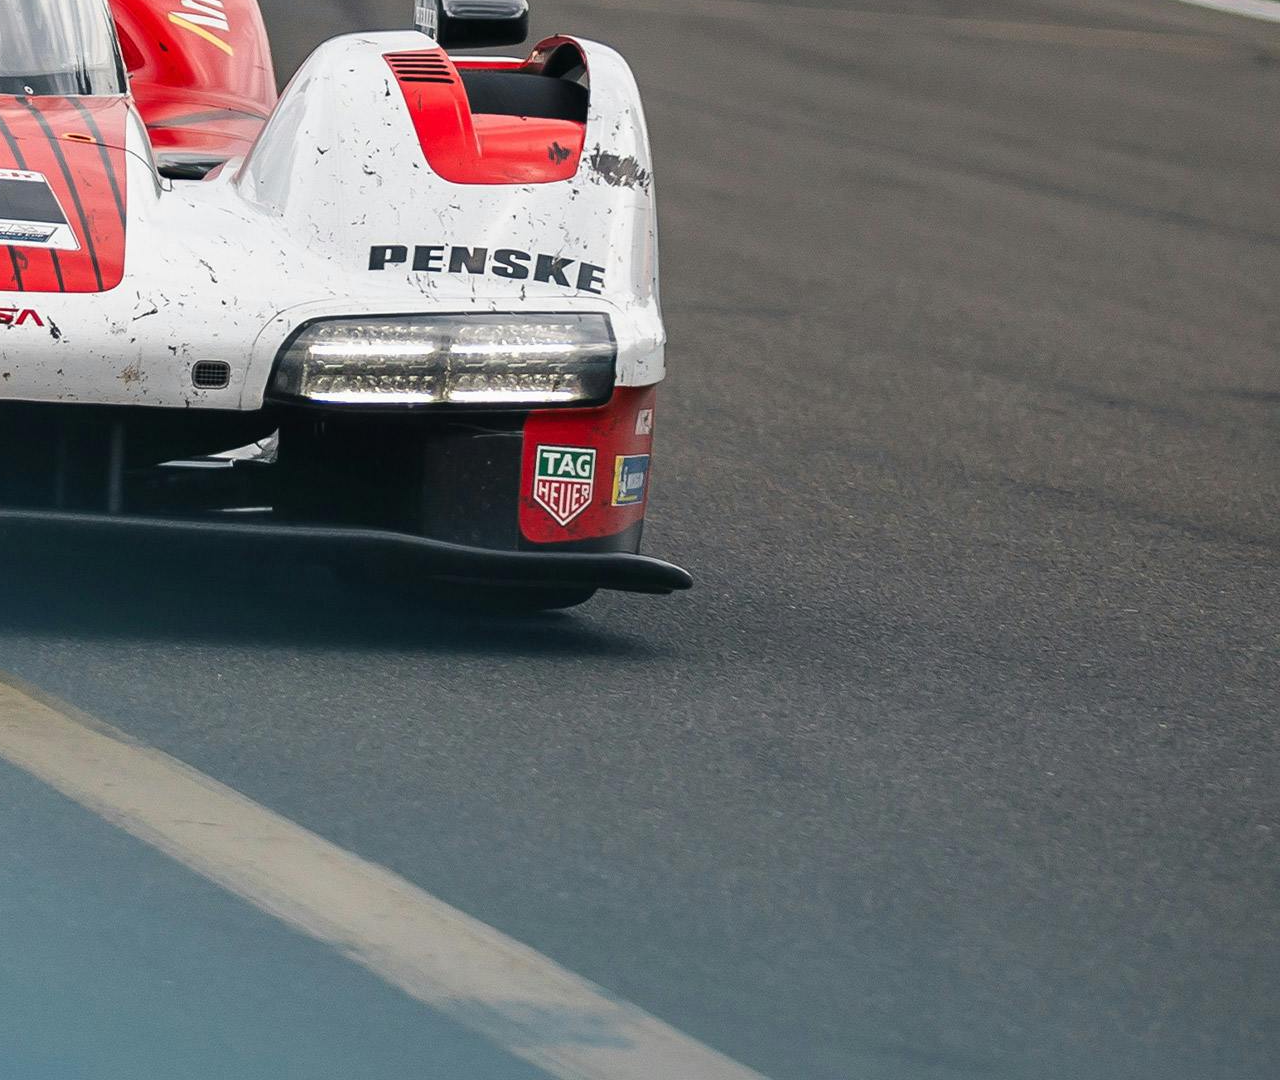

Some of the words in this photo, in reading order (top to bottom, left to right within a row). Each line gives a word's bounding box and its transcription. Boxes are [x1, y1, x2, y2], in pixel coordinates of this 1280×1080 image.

[368, 245, 606, 294] PENSKE
[542, 452, 591, 477] TAG
[538, 481, 590, 519] HEUER
